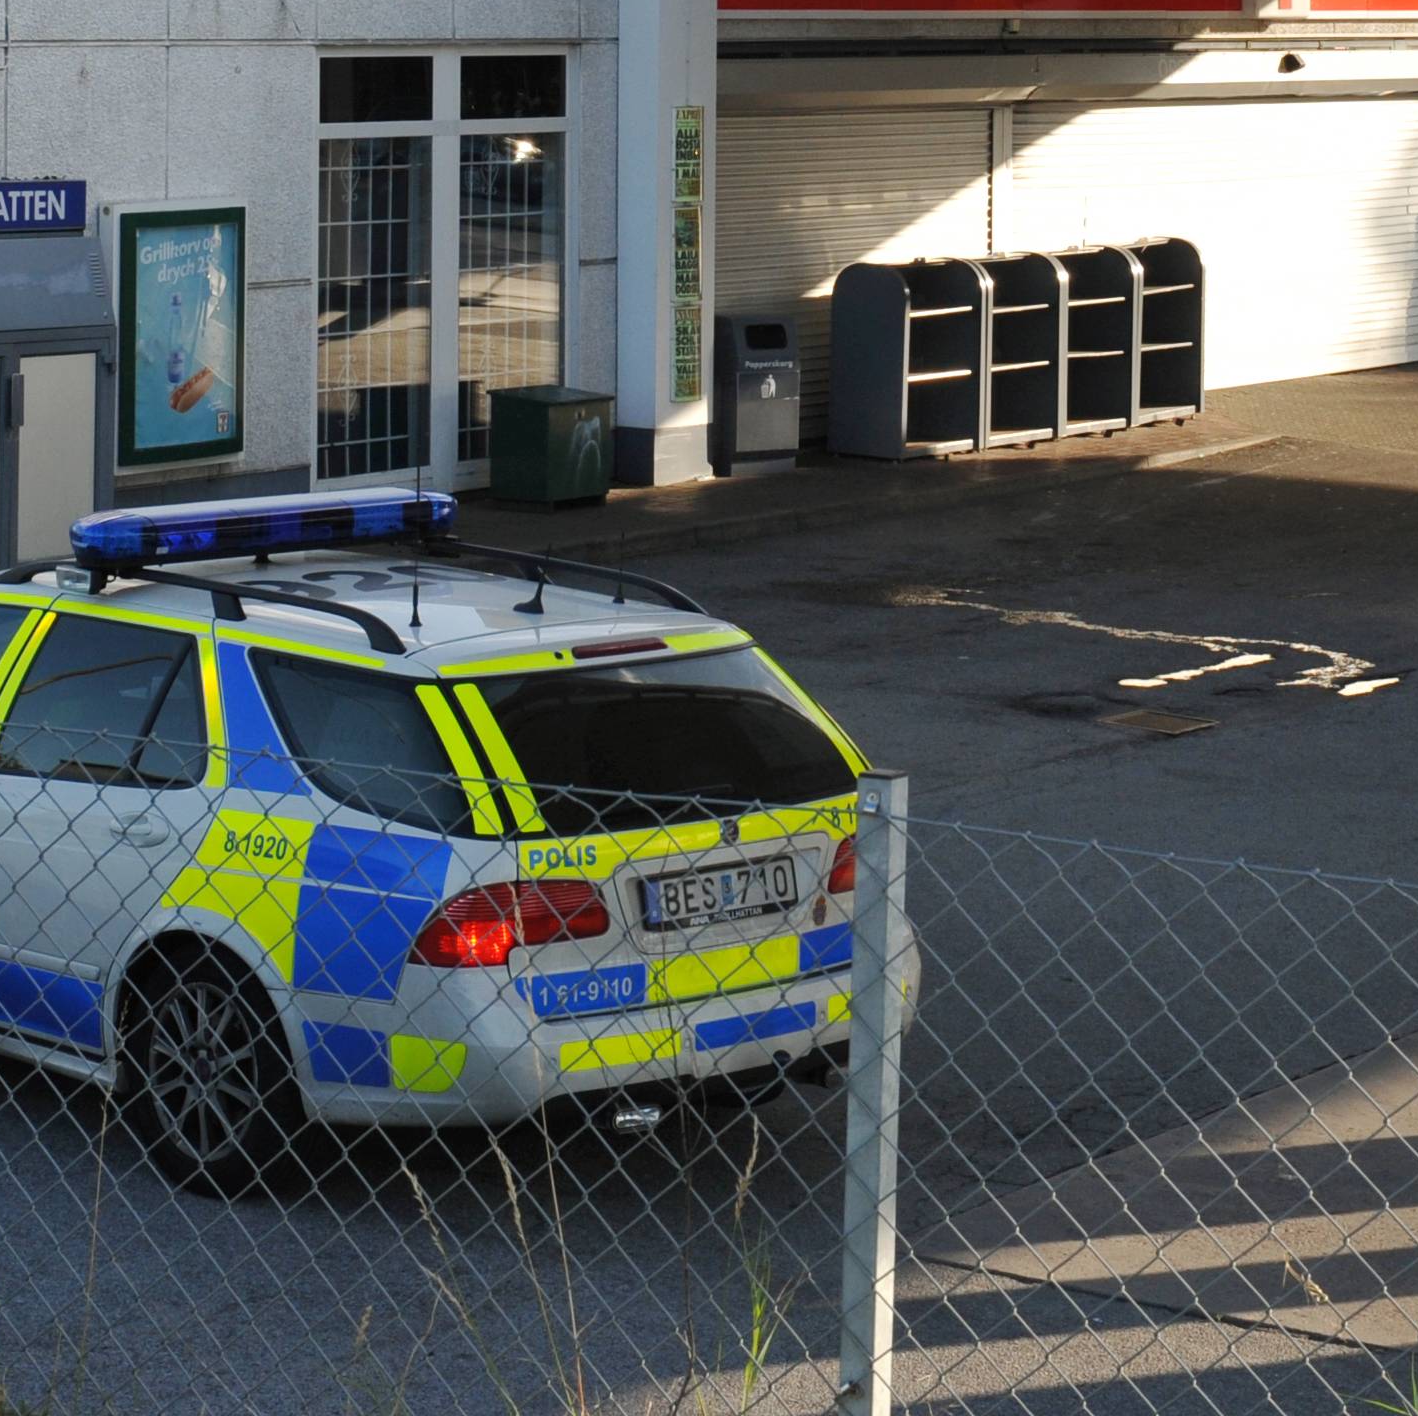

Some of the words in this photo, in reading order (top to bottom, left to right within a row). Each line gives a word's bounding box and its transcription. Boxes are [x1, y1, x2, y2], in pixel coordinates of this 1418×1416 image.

[141, 239, 201, 265] Grillkorv
[158, 258, 195, 285] dryck
[528, 845, 597, 871] POLIS
[663, 877, 717, 916] BES
[736, 864, 788, 904] 710
[557, 976, 632, 1005] 61-9110
